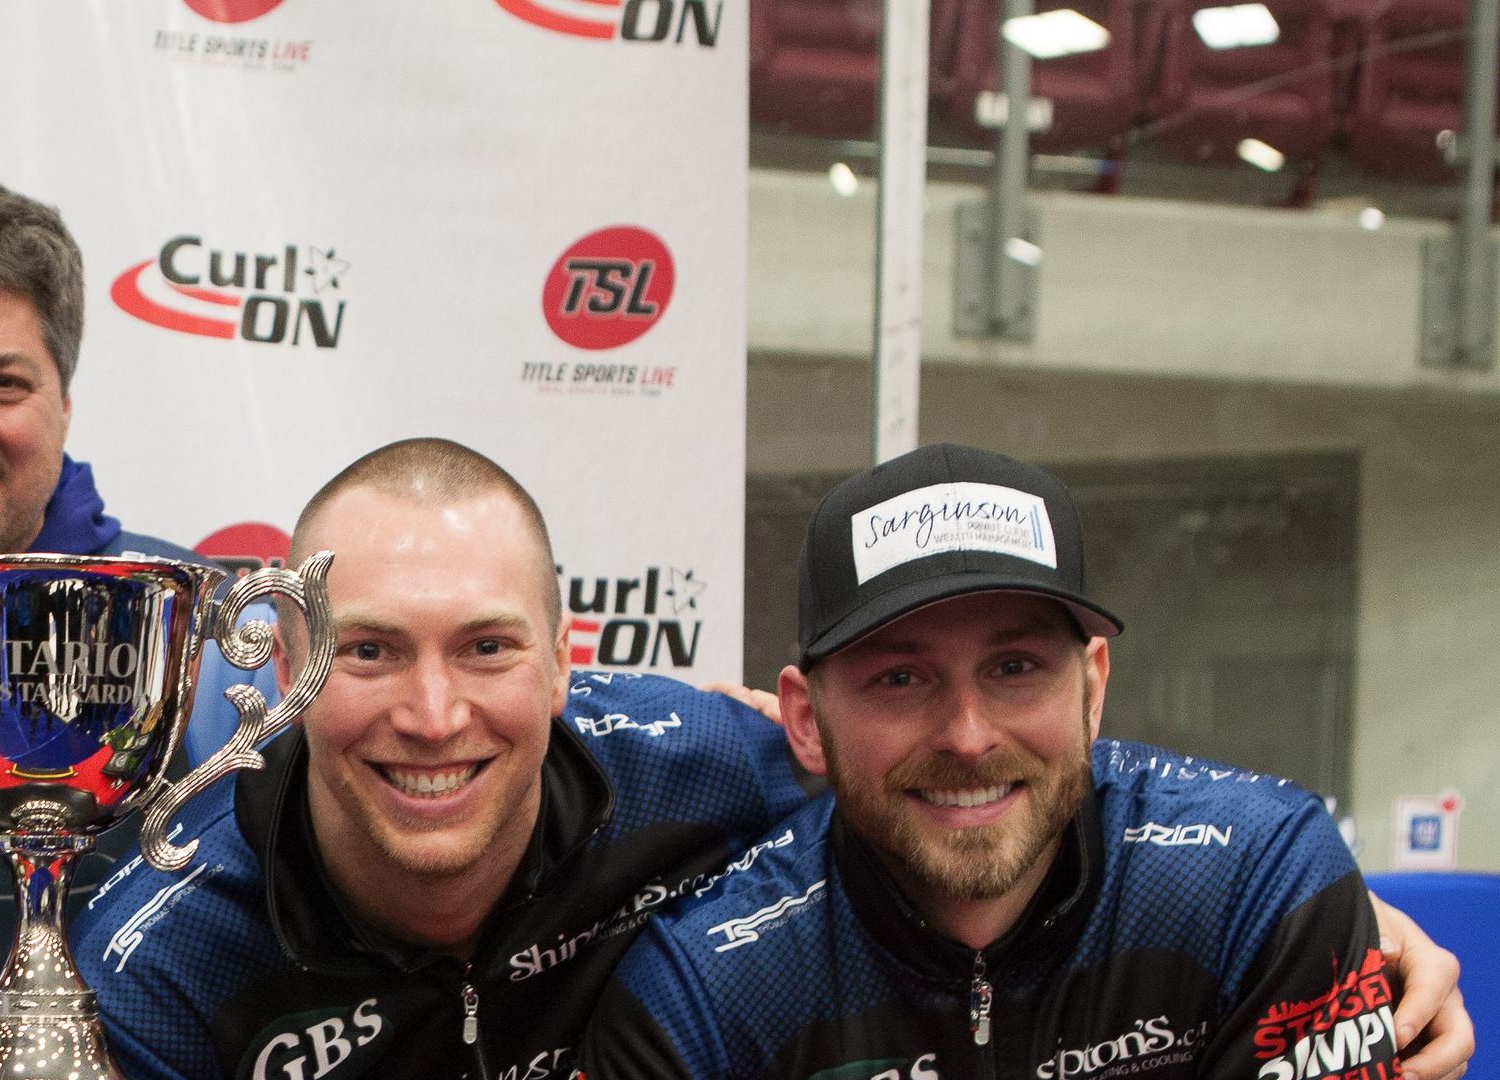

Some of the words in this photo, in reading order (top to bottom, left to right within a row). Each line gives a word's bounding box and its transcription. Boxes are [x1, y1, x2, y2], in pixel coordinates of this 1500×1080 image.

[204, 36, 269, 58] SPORTS
[621, 0, 723, 48] ON
[159, 236, 297, 293] Curl
[562, 259, 657, 317] TSL
[239, 298, 347, 350] ON
[521, 362, 567, 383] TITLE
[573, 363, 638, 385] SPORTS
[641, 366, 677, 388] LIVE
[865, 500, 1027, 549] Sarginson
[555, 563, 661, 615] url
[597, 618, 701, 668] ON
[17, 682, 134, 704] TANKARD
[88, 822, 184, 910] FZION
